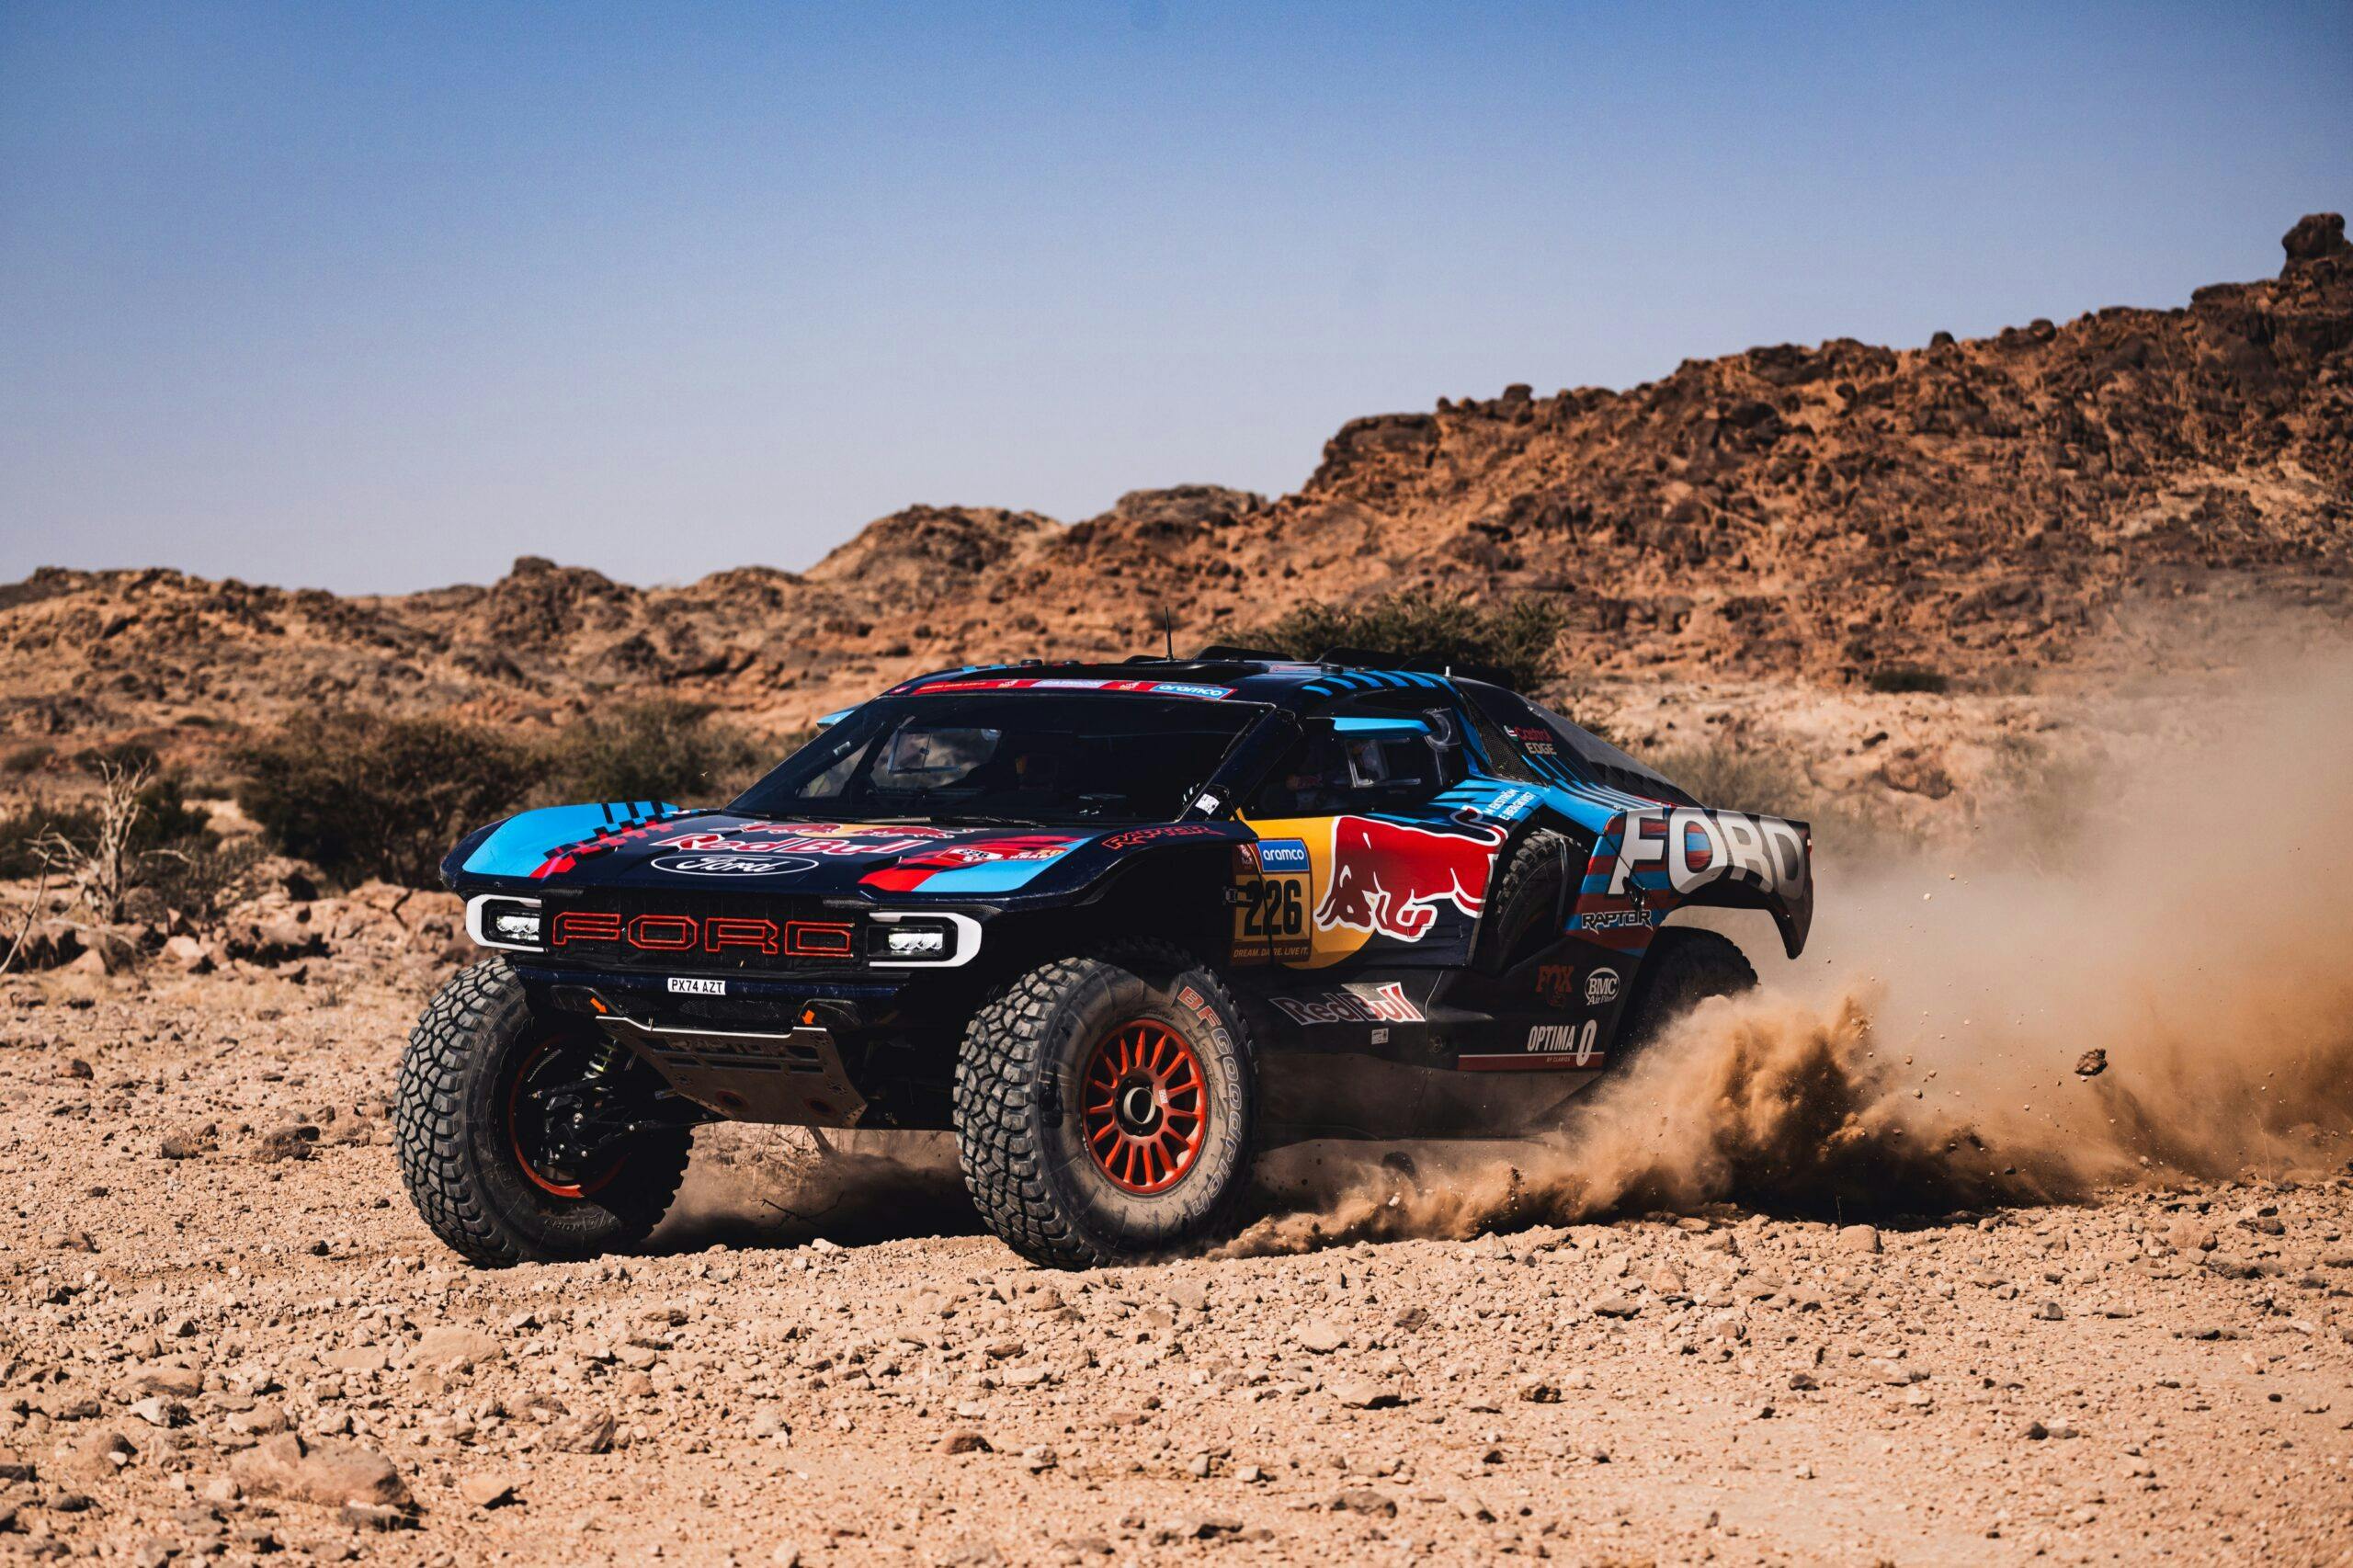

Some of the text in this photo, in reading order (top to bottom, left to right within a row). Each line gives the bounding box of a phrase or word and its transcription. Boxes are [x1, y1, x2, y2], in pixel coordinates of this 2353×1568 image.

[1159, 683, 1222, 696] aramco
[1525, 743, 1557, 755] EDGE
[1263, 849, 1304, 860] aramco
[1608, 806, 1806, 901] FORD
[676, 857, 790, 873] Ford
[1244, 880, 1302, 936] 226
[1581, 909, 1653, 935] RAPTOR
[553, 912, 855, 957] FORD
[672, 979, 722, 994] PX74 AZT
[1536, 965, 1574, 994] FOX
[1588, 978, 1617, 995] BMC
[1528, 1025, 1575, 1052] OPTIMA
